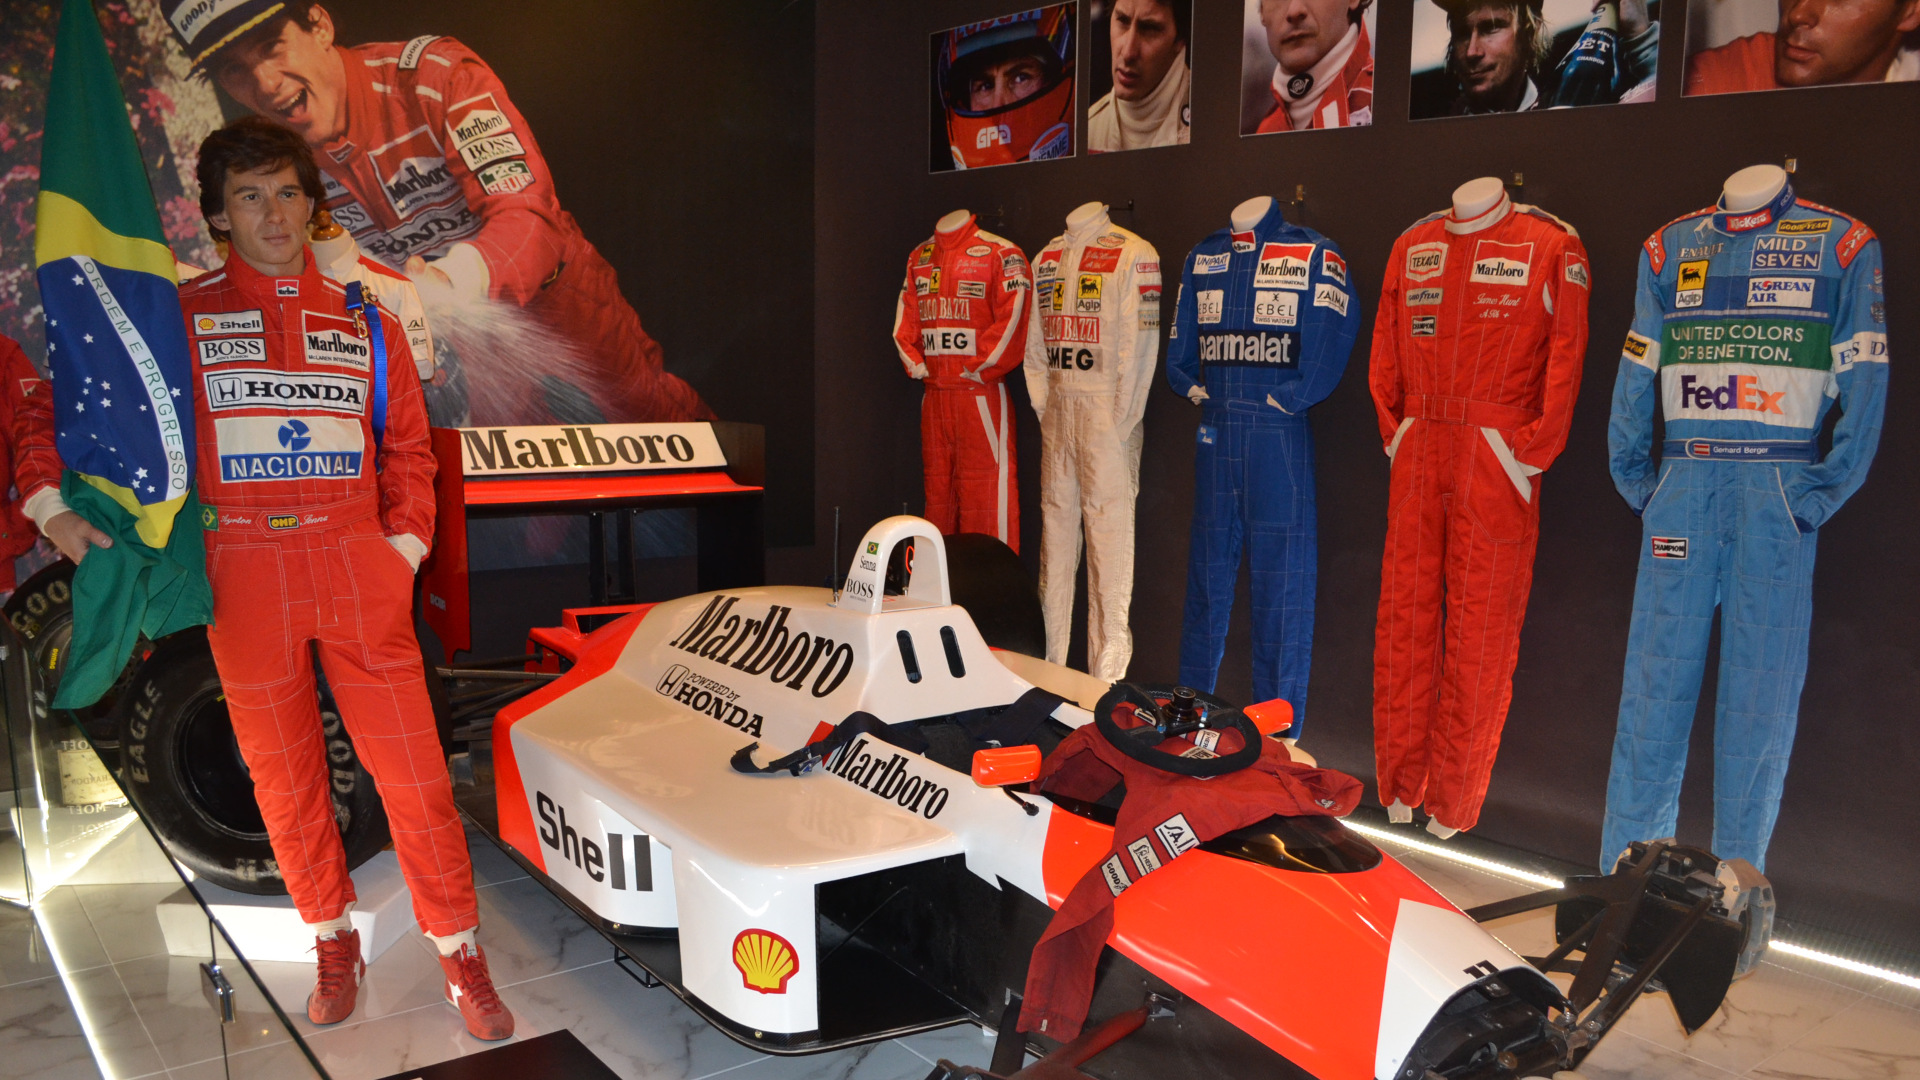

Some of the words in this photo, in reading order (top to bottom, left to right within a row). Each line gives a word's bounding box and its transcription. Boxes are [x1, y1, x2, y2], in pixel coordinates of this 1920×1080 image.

[180, 0, 216, 32] GOOD
[1576, 55, 1605, 66] CHANDON
[456, 114, 503, 142] Marlboro
[467, 136, 514, 160] BOSS
[333, 205, 366, 228] SS
[1780, 220, 1828, 231] GOODYEAR
[1680, 243, 1724, 258] ENAULT
[1757, 238, 1807, 251] MILD
[1197, 254, 1229, 266] UNIPART
[1260, 259, 1306, 277] Marlboro
[1412, 255, 1439, 267] TEXACO
[1755, 253, 1818, 267] SEVEN
[1474, 262, 1524, 278] Marlboro
[1751, 280, 1811, 292] KOREAN
[1078, 299, 1100, 310] Agip
[1678, 292, 1701, 305] Agip
[1748, 293, 1777, 303] AIR
[939, 297, 970, 320] BAZZI
[1256, 303, 1295, 316] EBEL
[220, 320, 260, 330] Shell
[1671, 326, 1724, 341] UNITED
[1728, 324, 1804, 342] COLORS
[203, 340, 261, 359] BOSS
[307, 333, 367, 357] Marlboro
[1199, 332, 1292, 363] parmalat
[1679, 346, 1694, 360] OF
[1697, 344, 1792, 361] BENETTON.
[1870, 341, 1888, 357] D
[333, 356, 367, 367] INTERNATIONAL
[83, 261, 132, 335] ORDEM
[129, 341, 143, 354] E
[138, 358, 186, 490] PROGRESSO
[245, 381, 361, 405] HONDA
[1681, 374, 1787, 415] FedEx
[460, 428, 695, 470] Marlboro
[1713, 446, 1741, 454] Gerhard
[1744, 447, 1769, 455] Berger
[230, 455, 356, 478] NACIONAL
[271, 517, 296, 527] OMP
[300, 514, 328, 526] Senna
[1654, 543, 1685, 552] CHAMPION
[860, 556, 876, 572] Senna
[847, 579, 874, 598] BOSS
[669, 595, 854, 698] Marlboro
[687, 673, 730, 696] POWERED
[673, 683, 764, 739] HONDA
[129, 680, 162, 783] EAGLE
[826, 738, 949, 819] Marlboro
[537, 790, 653, 891] Shell
